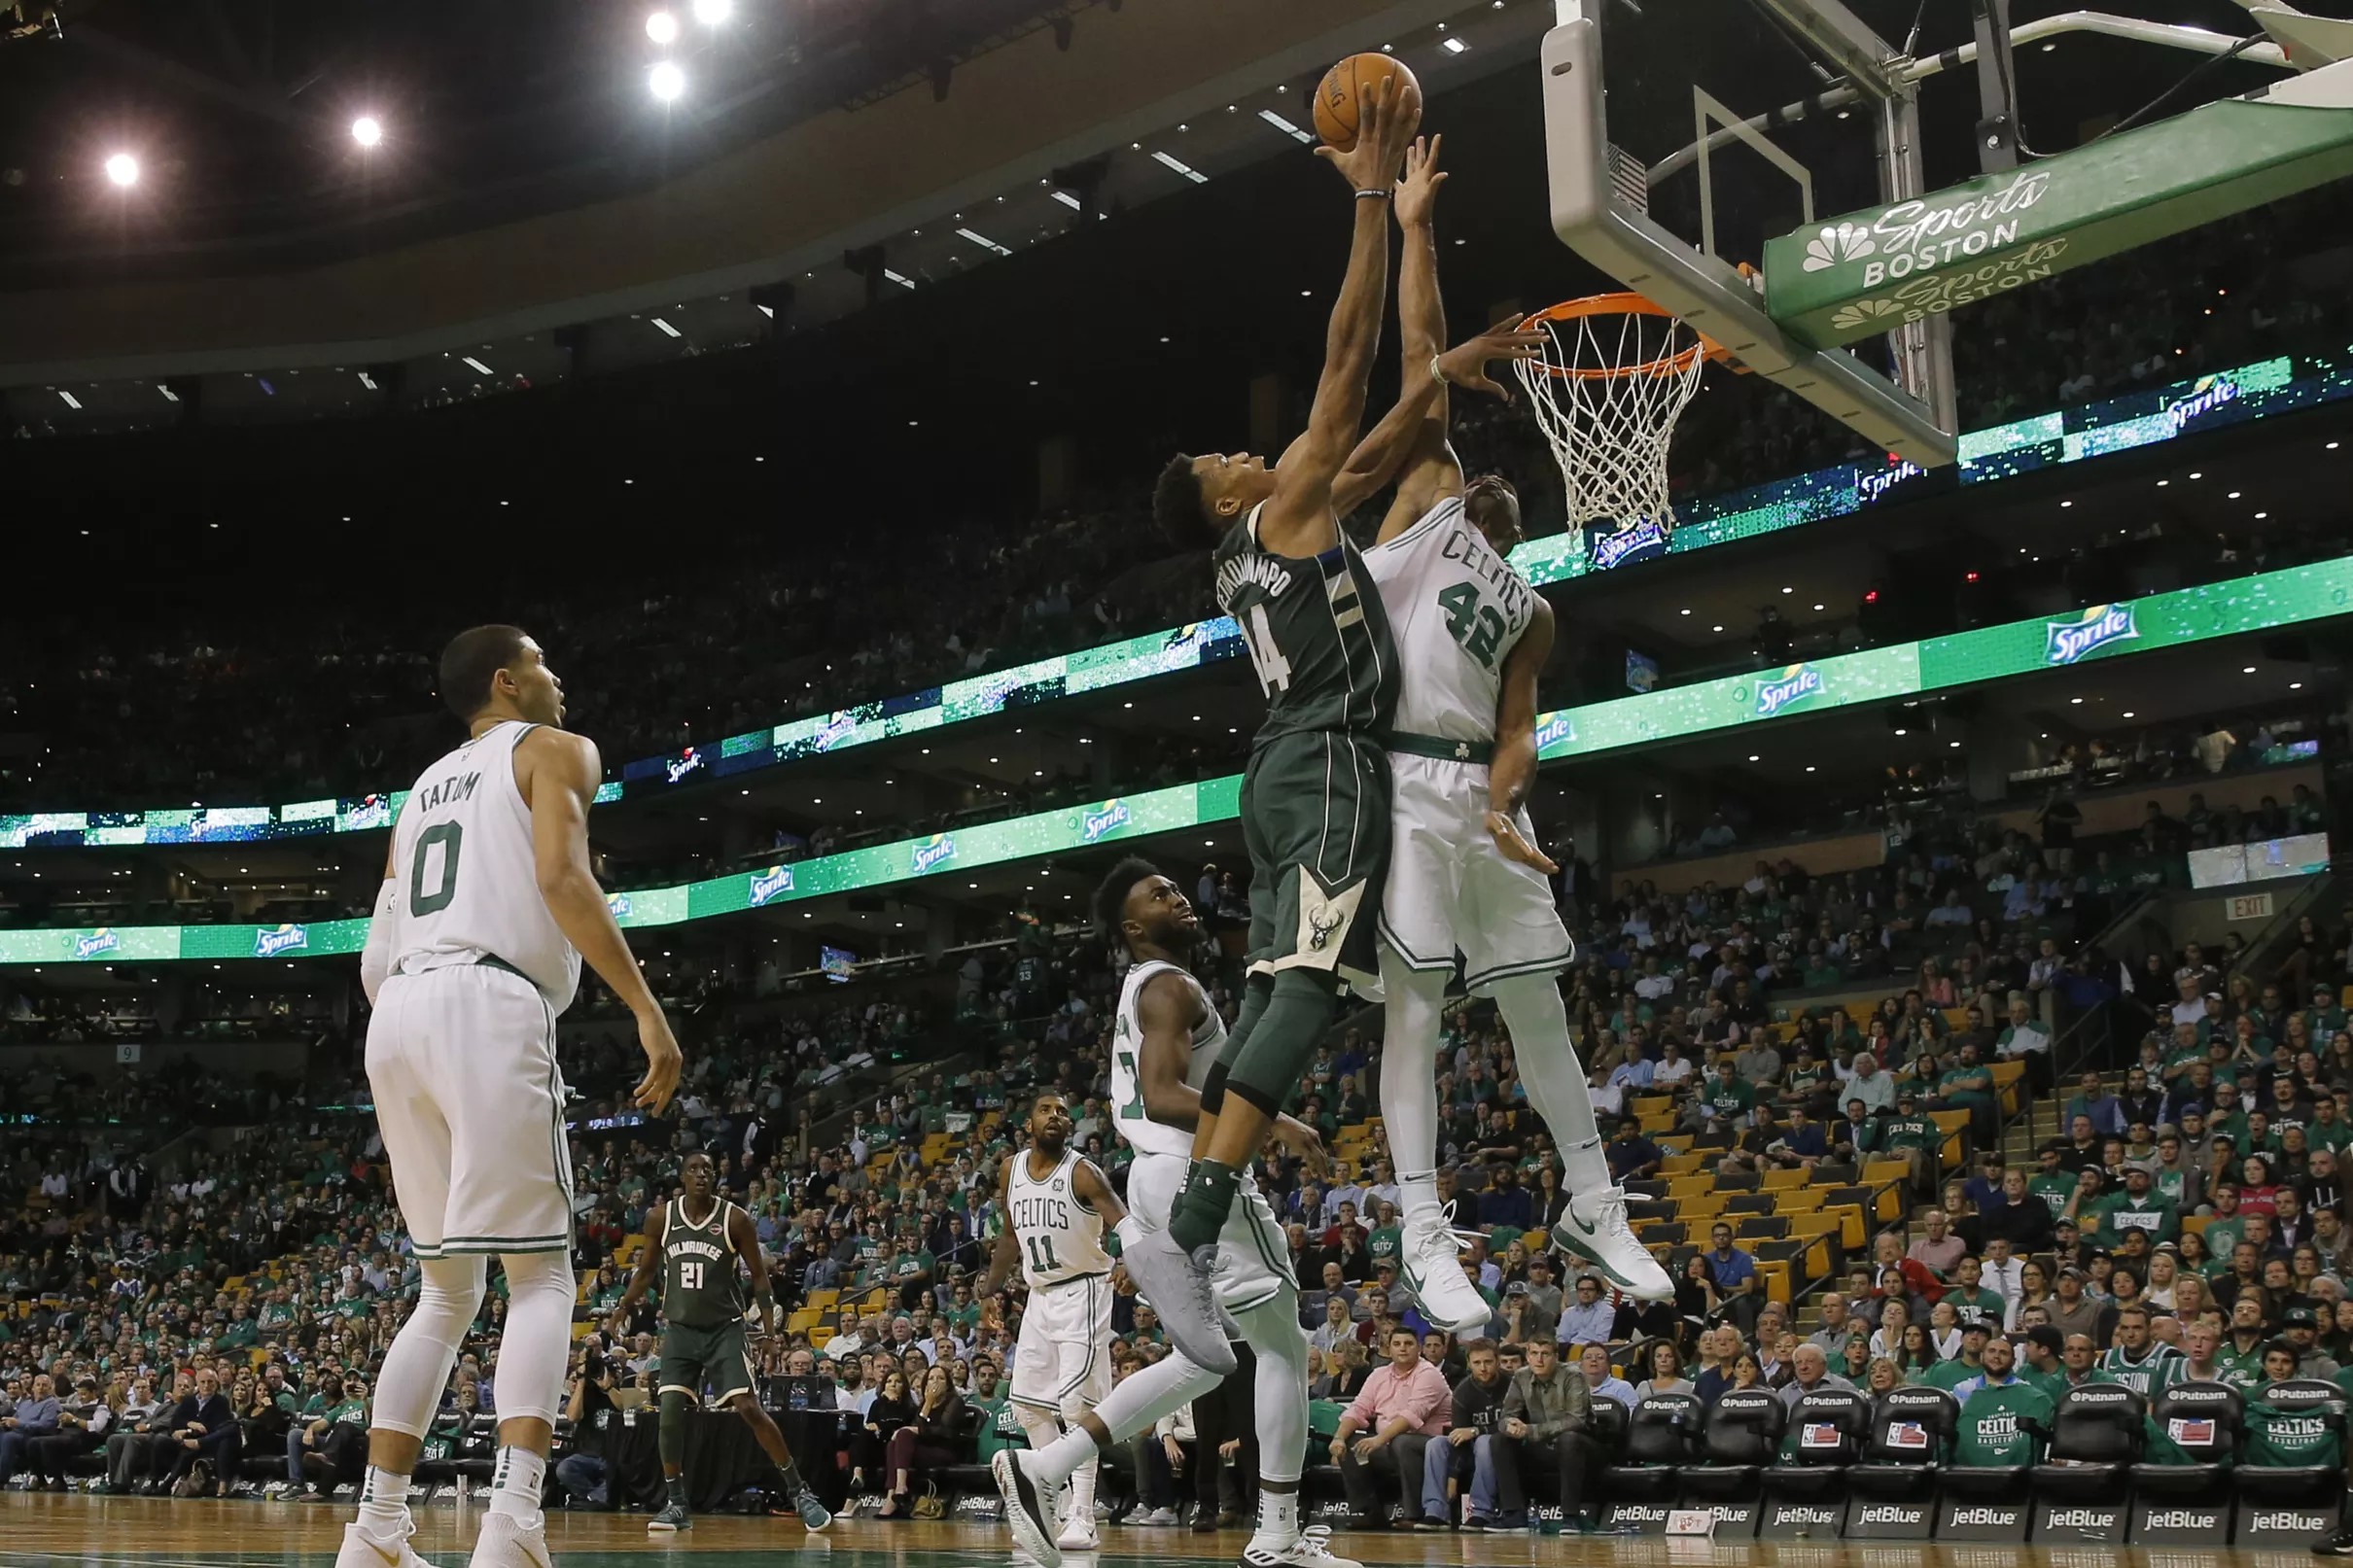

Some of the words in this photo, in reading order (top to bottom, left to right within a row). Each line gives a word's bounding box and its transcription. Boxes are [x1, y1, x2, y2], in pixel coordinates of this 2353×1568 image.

[1874, 171, 2051, 255] Sports
[1863, 218, 2019, 289] BOSTON
[1894, 238, 2068, 306] Sports
[1903, 263, 2054, 323] BOSTON
[2166, 377, 2237, 428] Sprite
[1442, 530, 1528, 636] CELTICS
[1438, 581, 1506, 669] 42
[2051, 607, 2128, 663] Sprite
[1757, 670, 1818, 714] Sprite
[1537, 719, 1568, 748] rite
[668, 752, 702, 783] Sprite
[420, 771, 481, 813] TATUM
[1085, 802, 1129, 838] Sprite
[914, 838, 954, 871] Sprite
[410, 819, 463, 918] 0
[752, 868, 790, 905] Sprite
[2235, 897, 2265, 918] EXIT
[77, 931, 119, 956] Sprite
[259, 926, 305, 955] Sprite
[123, 1046, 132, 1061] 9
[1013, 1198, 1069, 1230] CELTICS
[667, 1240, 723, 1262] MILWAUKEE
[1027, 1236, 1063, 1272] 11
[681, 1262, 704, 1289] 21
[1730, 1397, 1769, 1408] Putnam
[1812, 1396, 1852, 1406] Putnam
[1899, 1394, 1941, 1405] Putnam
[2081, 1391, 2127, 1402] Putnam
[2179, 1390, 2228, 1401] Putnam
[2279, 1387, 2330, 1400] Putnam
[1977, 1415, 2018, 1435] CELTIC
[2267, 1418, 2326, 1435] CELTICS
[408, 1484, 426, 1496] Blue
[434, 1485, 457, 1498] jetBlu
[957, 1496, 997, 1512] jetBlue
[1610, 1506, 1666, 1523] jetBlue
[1859, 1506, 1921, 1525] jetBlue
[1950, 1508, 2016, 1528] jetBlue
[2046, 1510, 2114, 1530] jetBlue
[2144, 1511, 2216, 1531] jetBlue
[2250, 1513, 2324, 1534] jetBlue
